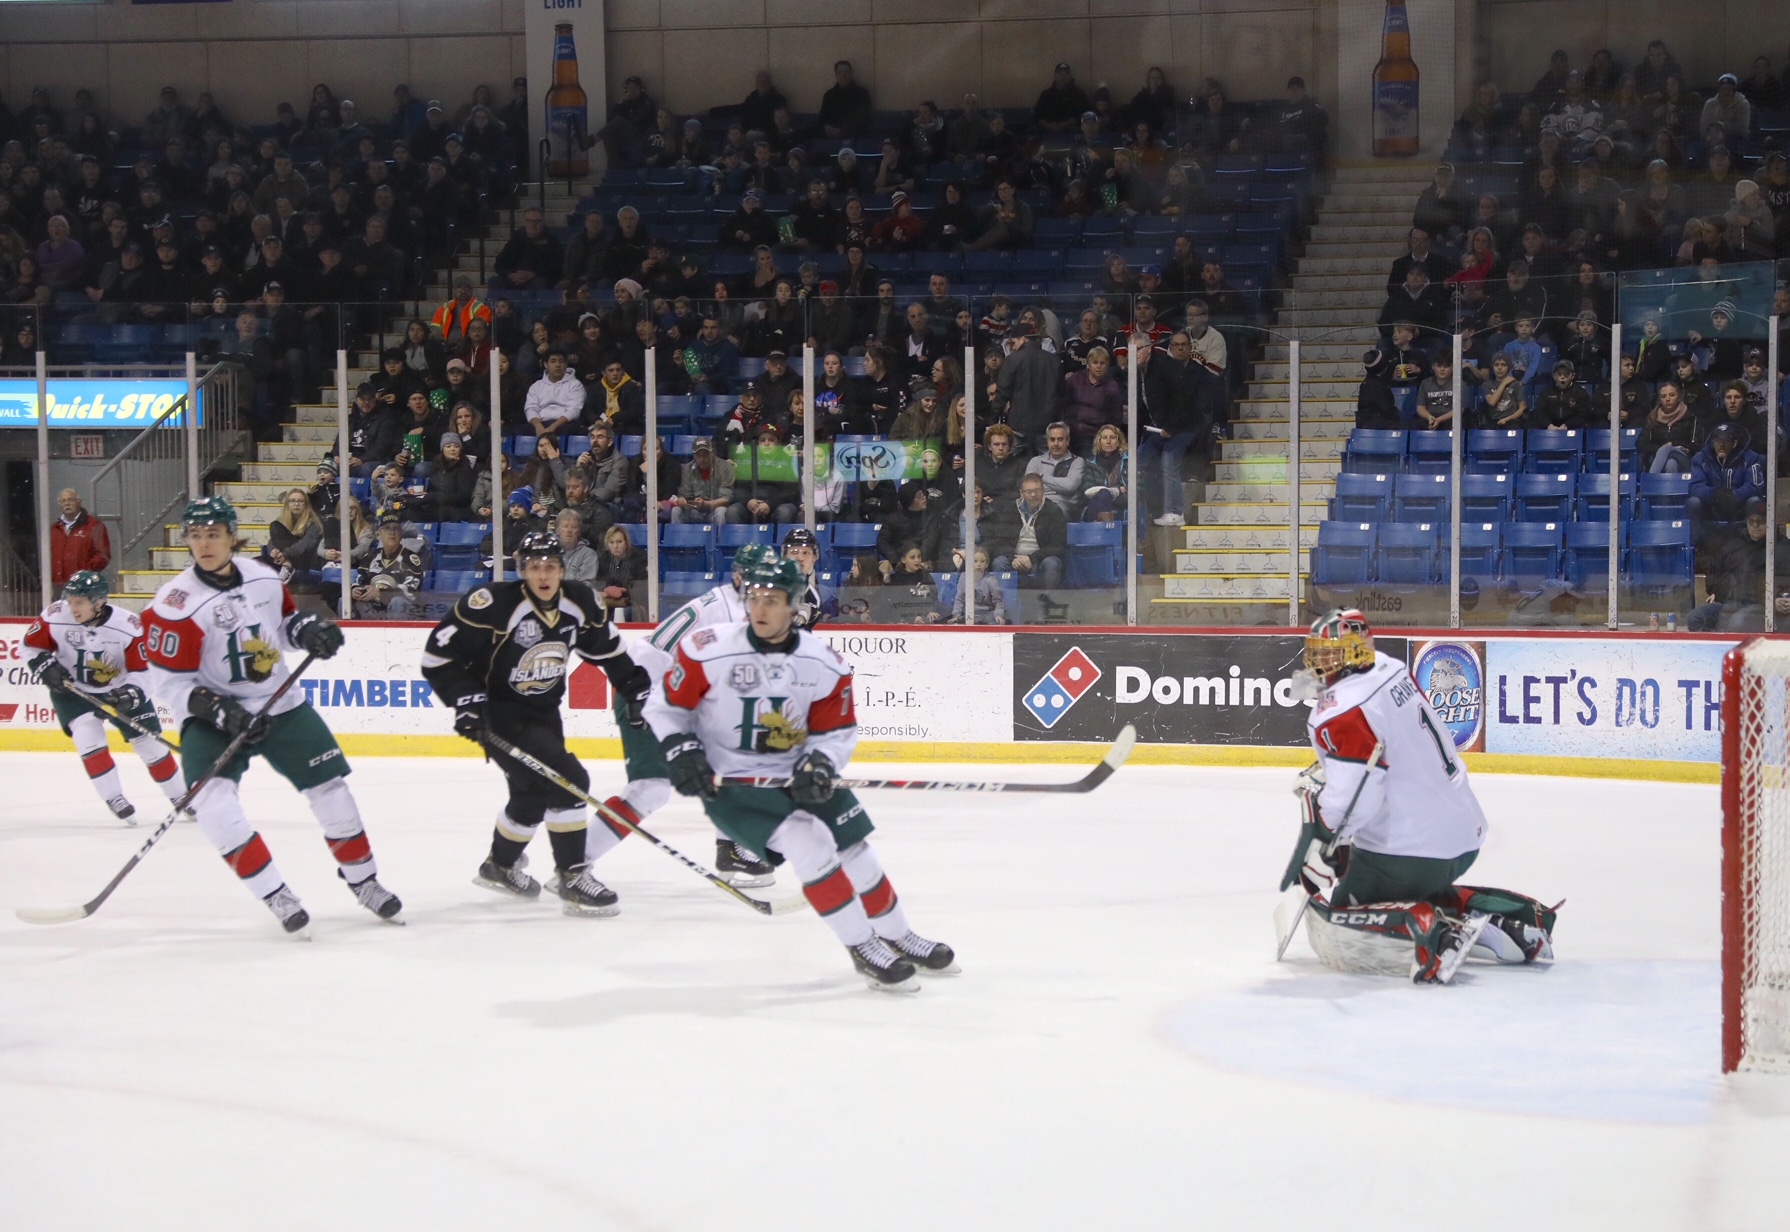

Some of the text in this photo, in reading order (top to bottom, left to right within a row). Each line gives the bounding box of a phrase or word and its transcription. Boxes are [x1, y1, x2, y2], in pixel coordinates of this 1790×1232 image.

[75, 437, 100, 456] EXIT
[435, 625, 458, 647] 4
[519, 621, 536, 637] 50
[147, 627, 180, 658] 50
[829, 637, 907, 656] LIQUOR
[1423, 648, 1442, 666] FIERCELY
[735, 665, 756, 682] 50
[300, 679, 434, 708] TIMBER
[1115, 665, 1318, 708] Domino
[1498, 668, 1598, 727] LET'S
[1614, 677, 1661, 729] DO
[857, 723, 931, 739] esponsibly.
[1330, 912, 1388, 926] CCM
